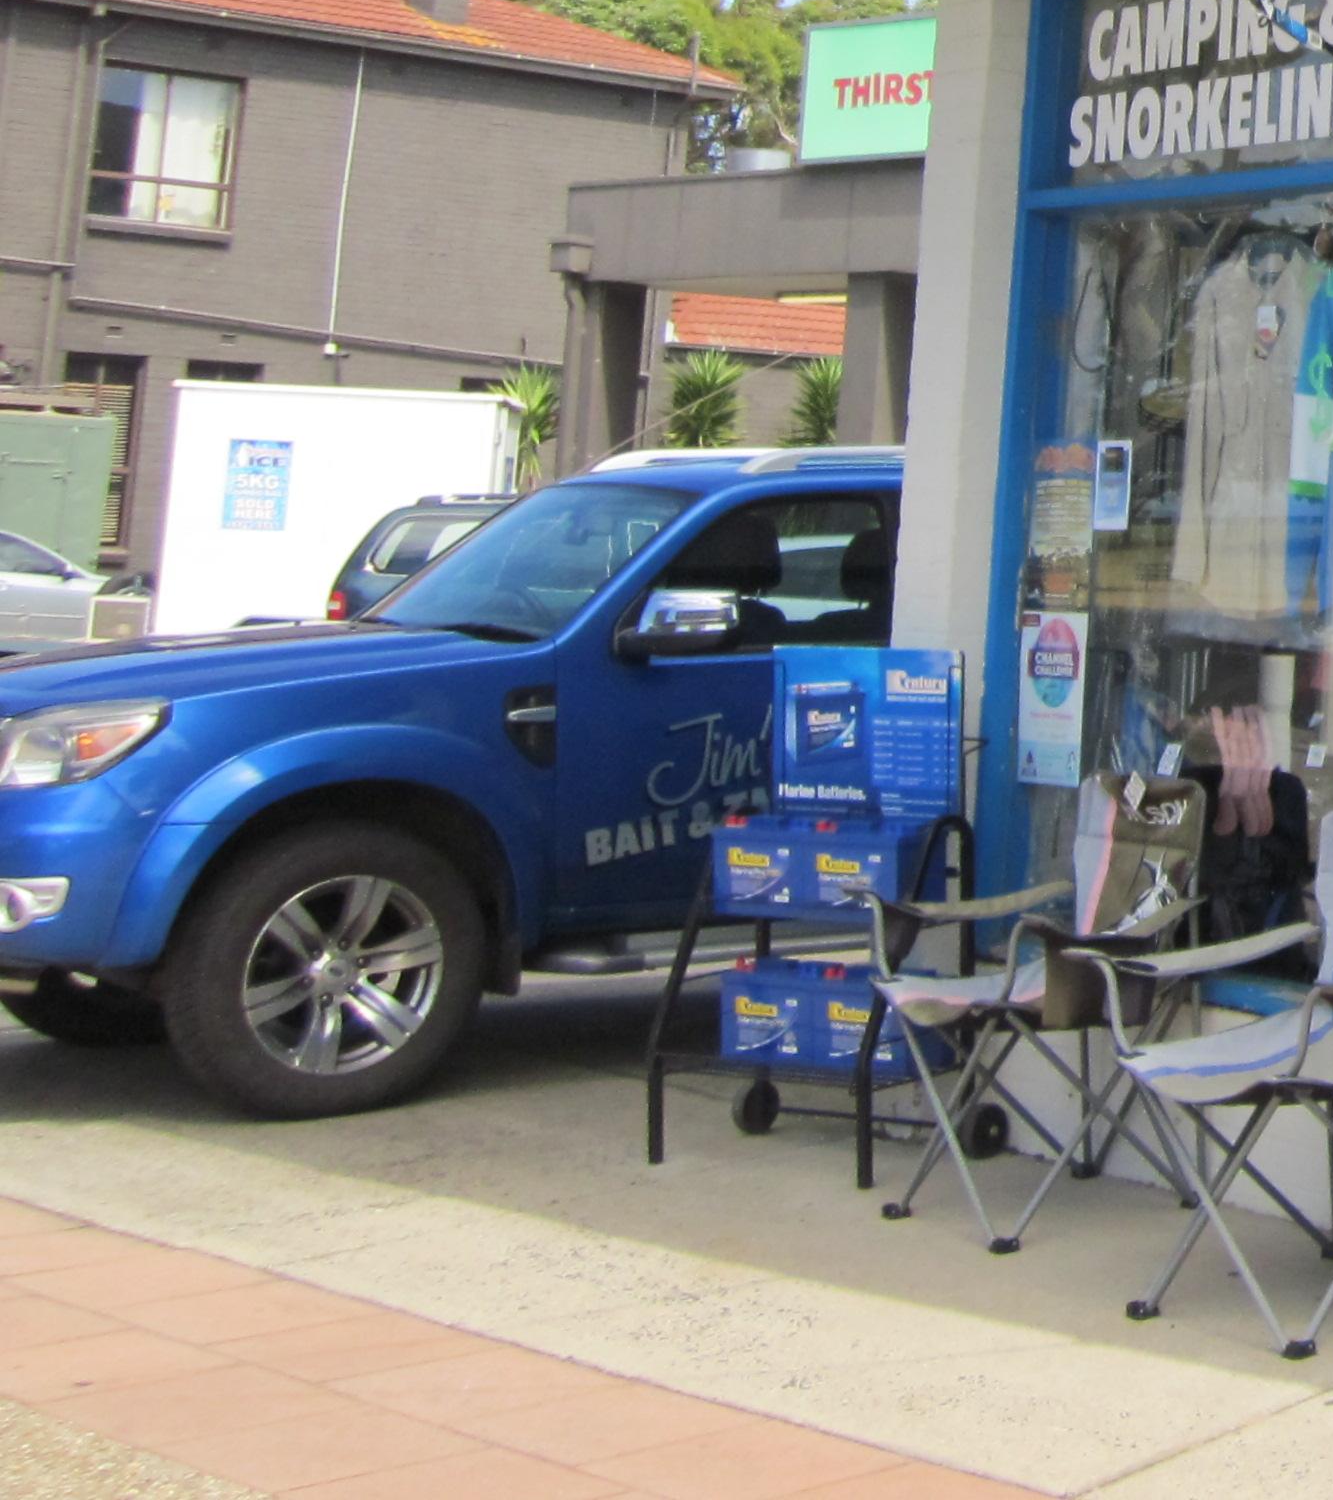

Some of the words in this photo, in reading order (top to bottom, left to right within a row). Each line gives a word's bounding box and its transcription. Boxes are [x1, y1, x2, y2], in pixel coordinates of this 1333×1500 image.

[834, 71, 934, 109] THIRST
[234, 474, 280, 489] 5KG
[1034, 652, 1074, 666] CHANNEL
[585, 809, 680, 866] BAIT
[688, 801, 714, 839] &
